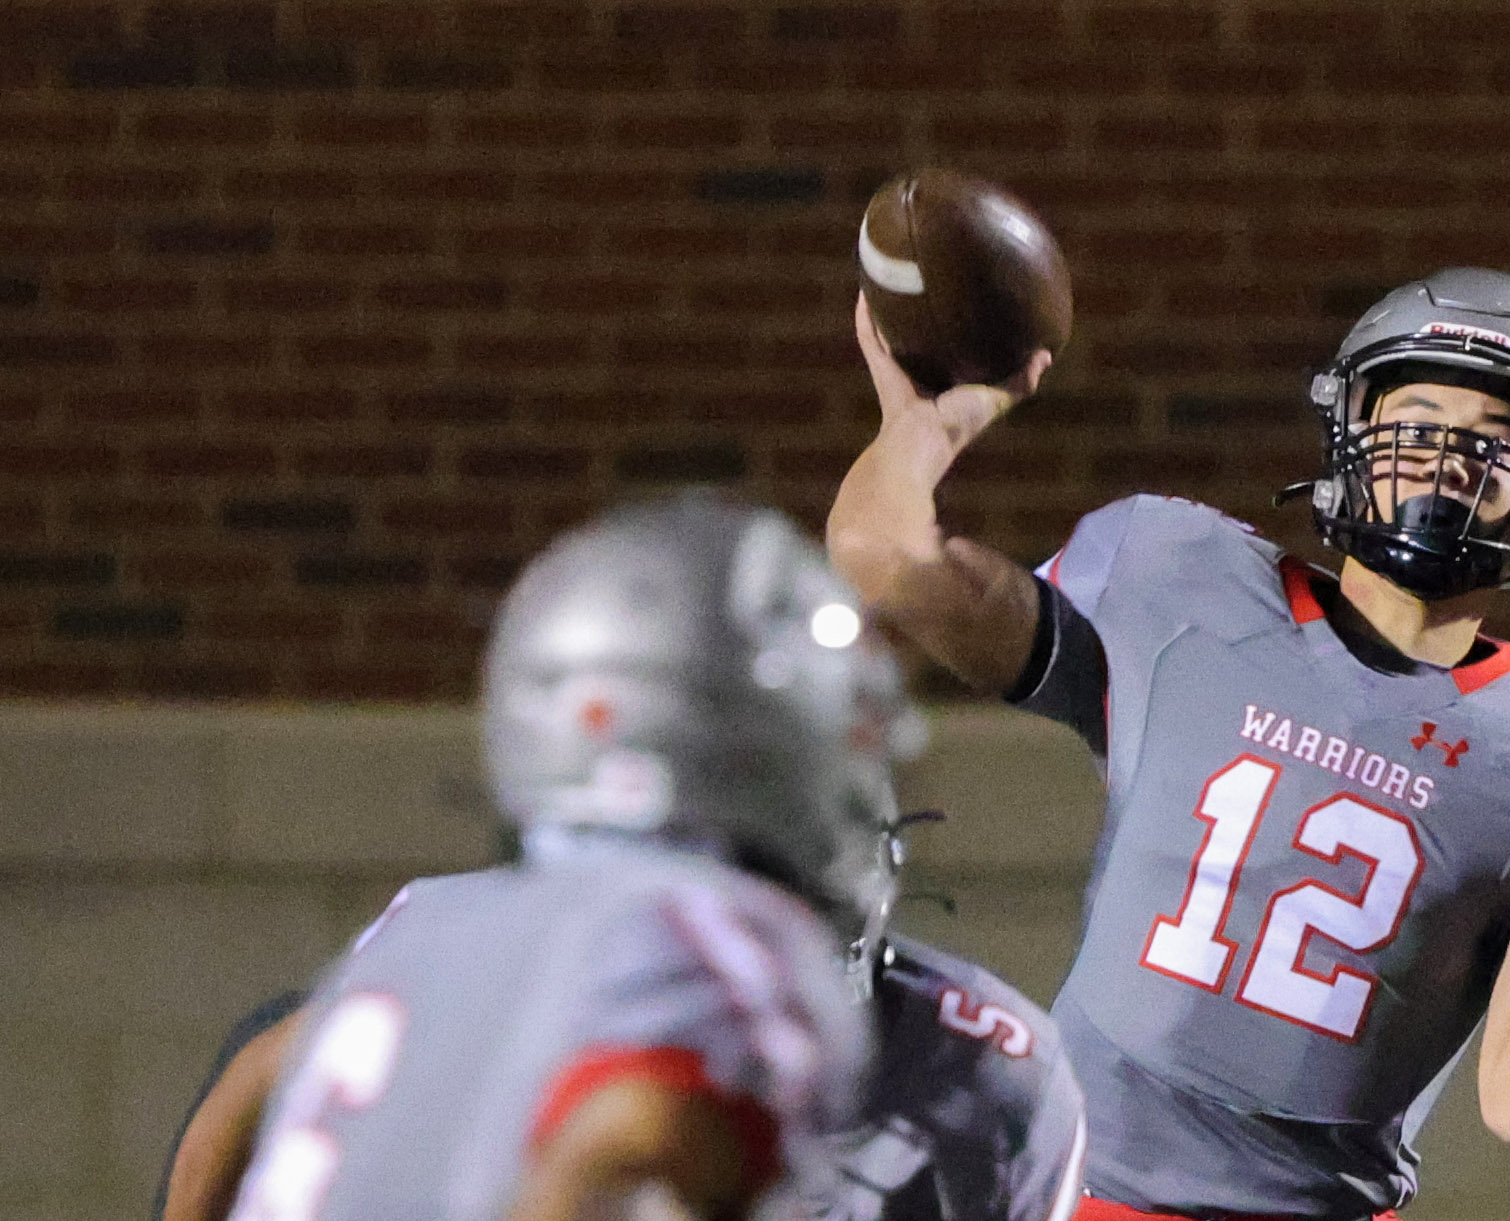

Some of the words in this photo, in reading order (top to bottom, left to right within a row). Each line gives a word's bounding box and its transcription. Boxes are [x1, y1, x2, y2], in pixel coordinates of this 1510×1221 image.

[1239, 704, 1435, 811] WARRIORS
[1139, 752, 1425, 1043] 12
[939, 985, 1036, 1060] 5
